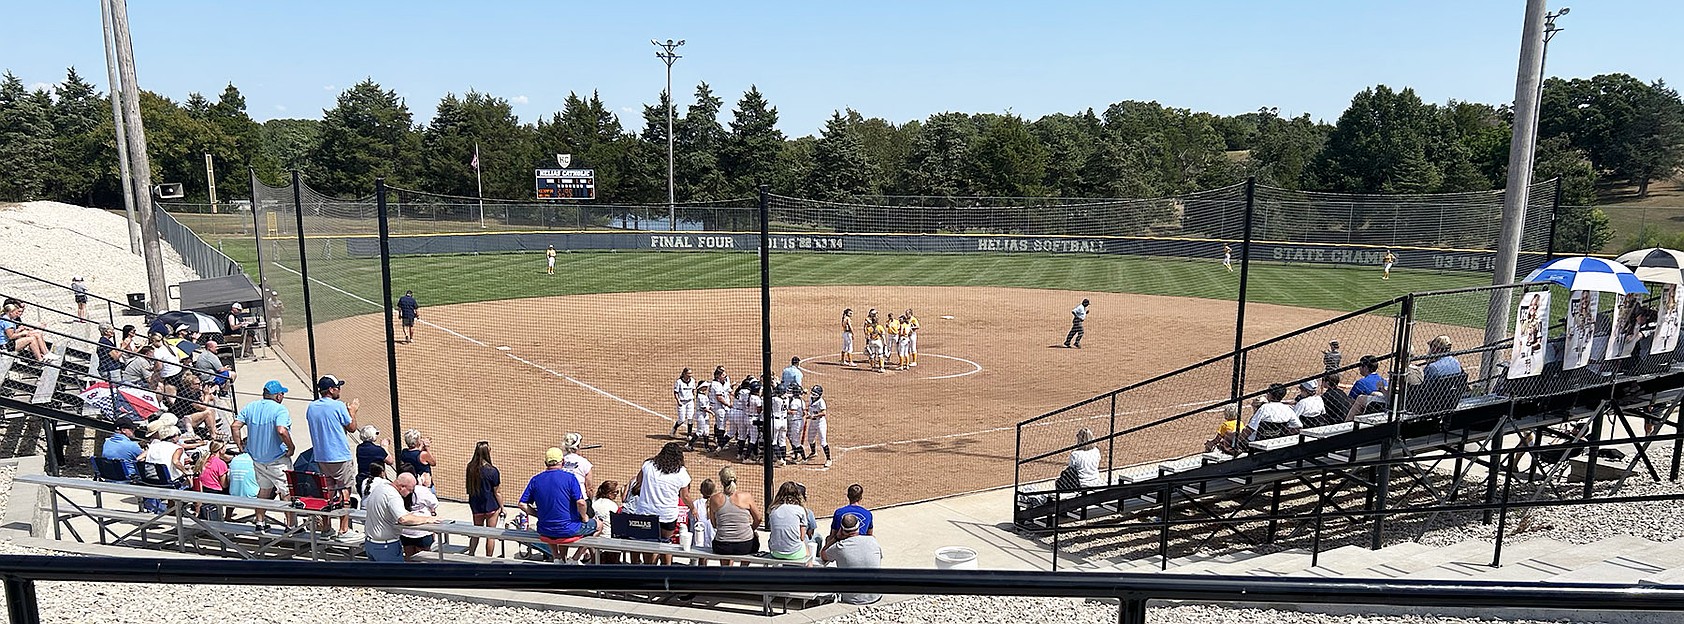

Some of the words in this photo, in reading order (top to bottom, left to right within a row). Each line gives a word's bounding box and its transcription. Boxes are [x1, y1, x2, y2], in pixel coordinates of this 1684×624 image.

[650, 235, 693, 248] FINAL
[698, 236, 735, 248] FOUR
[977, 239, 1028, 251] HELIAS
[1033, 239, 1107, 252] SOFTBALL
[1273, 247, 1325, 261] STATE
